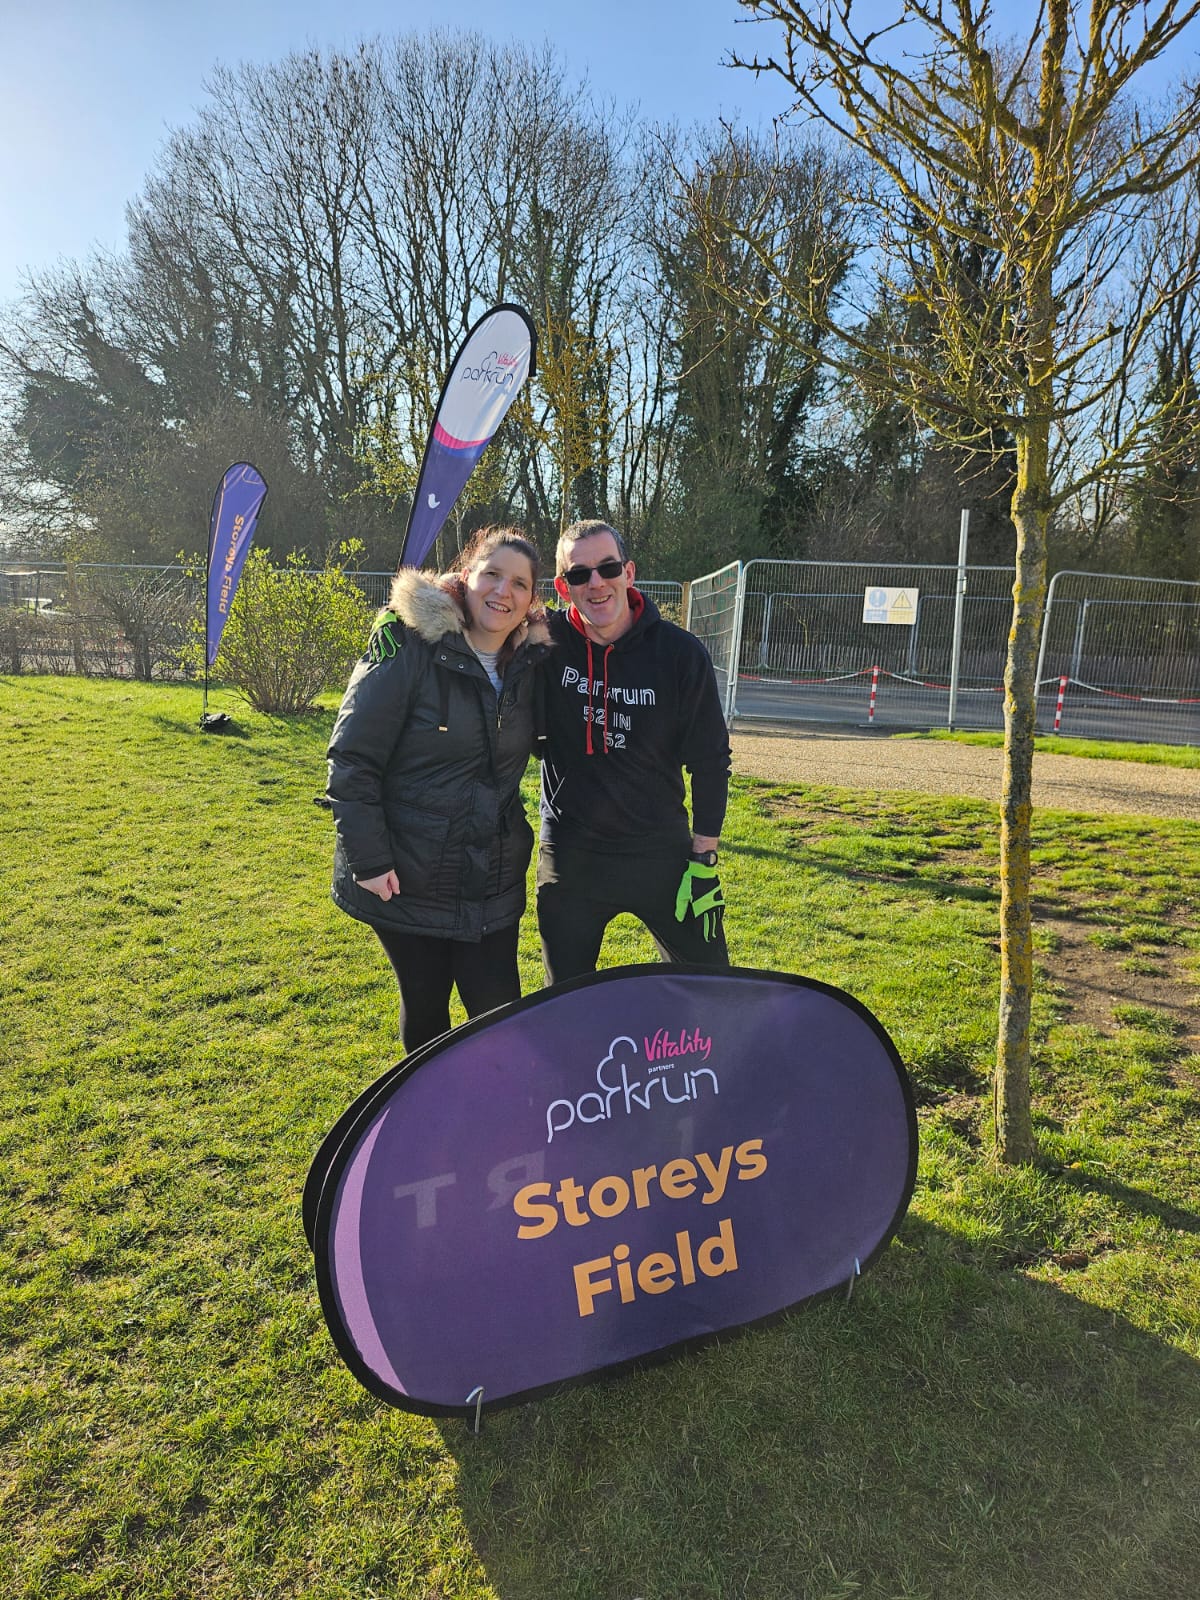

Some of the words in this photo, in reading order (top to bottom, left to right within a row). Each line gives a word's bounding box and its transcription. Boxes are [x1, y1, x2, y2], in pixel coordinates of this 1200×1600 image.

[225, 514, 245, 572] Storeys
[219, 575, 232, 614] Field
[583, 705, 606, 725] 52
[613, 711, 631, 731] IN
[603, 731, 626, 749] 52
[644, 1027, 712, 1062] Vitality
[648, 1063, 675, 1075] partners
[546, 1062, 719, 1143] parkrun
[513, 1139, 768, 1240] Storeys
[572, 1219, 739, 1317] Field
